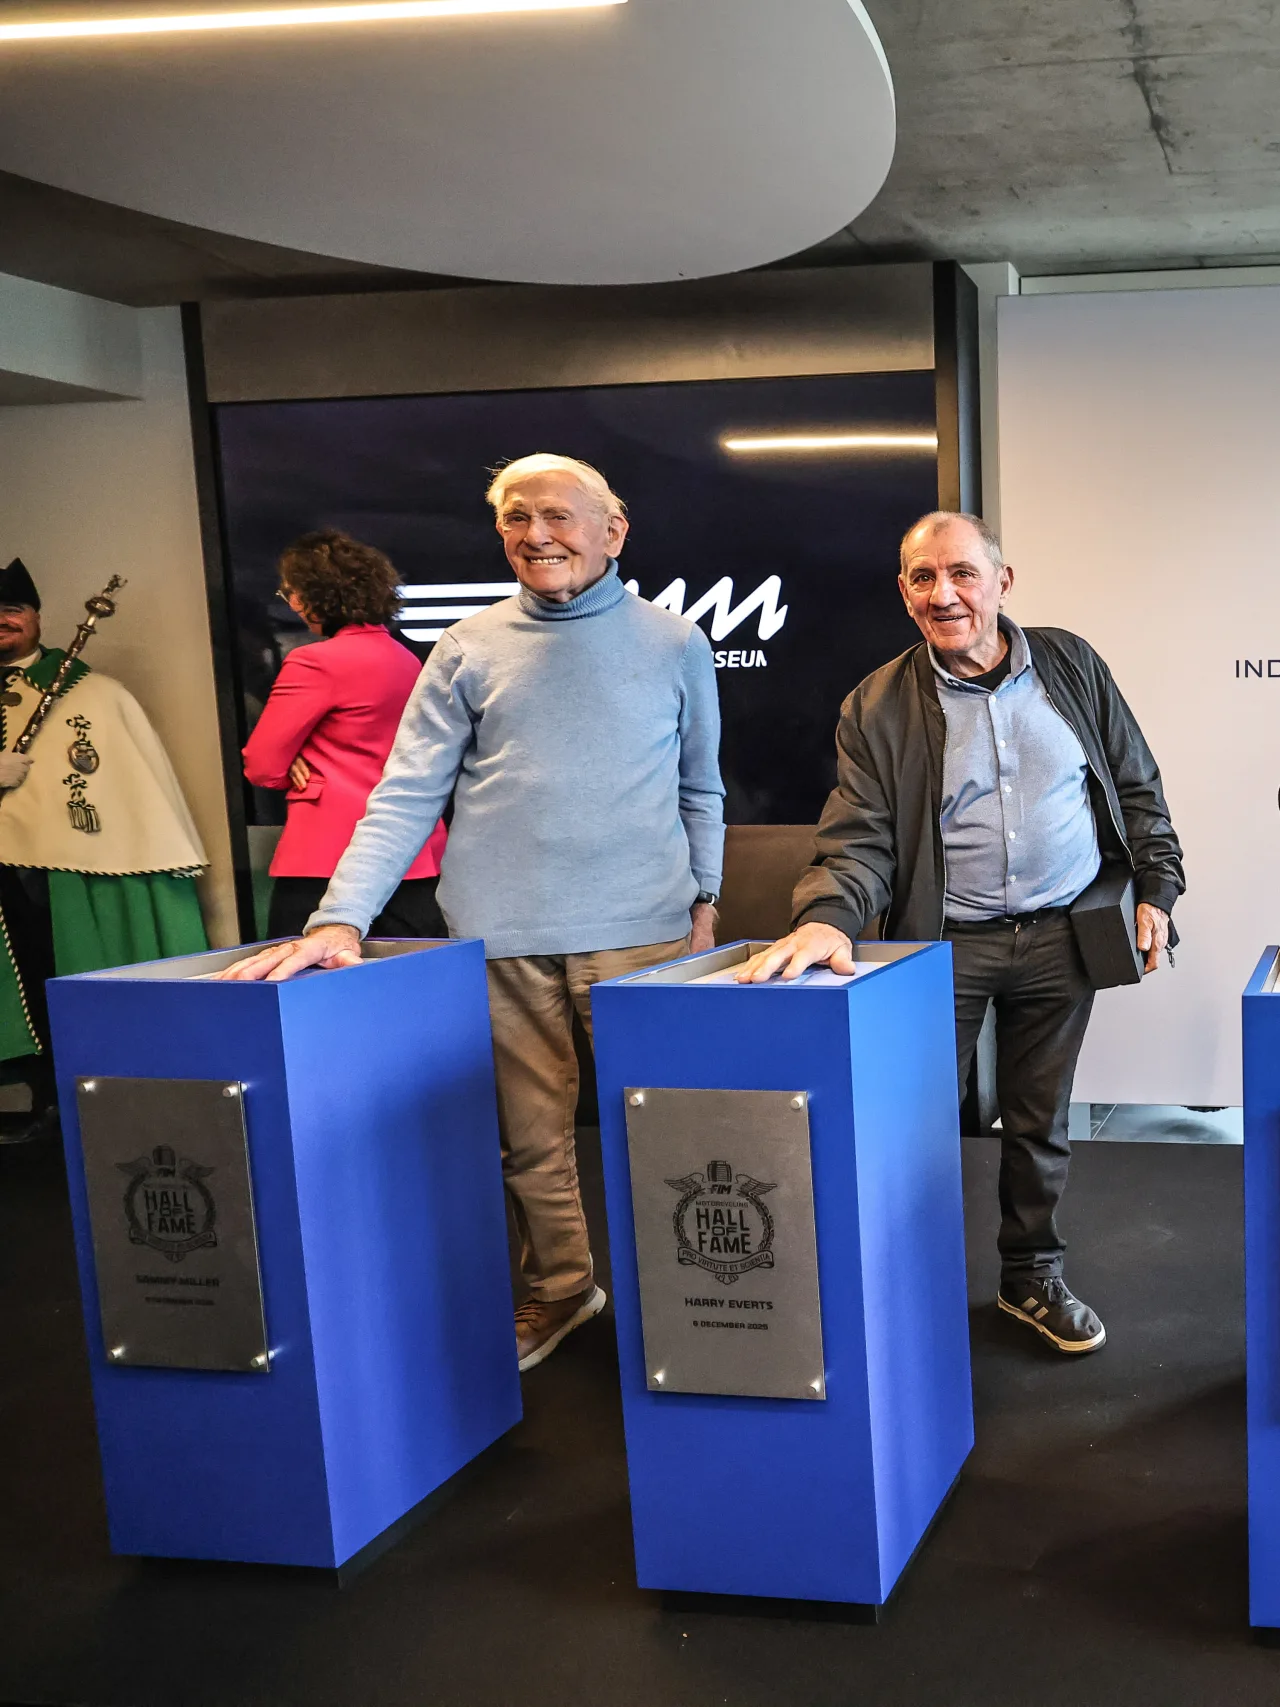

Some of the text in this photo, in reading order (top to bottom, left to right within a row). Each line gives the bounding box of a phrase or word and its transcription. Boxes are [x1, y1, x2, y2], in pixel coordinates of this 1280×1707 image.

[707, 1184, 732, 1194] FIM
[143, 1189, 194, 1213] HALL
[146, 1212, 197, 1235] FAME
[696, 1208, 750, 1231] HALL
[712, 1226, 737, 1236] OF
[698, 1232, 751, 1254] FAME
[682, 1250, 697, 1260] PRO
[685, 1298, 773, 1310] HARRY EVERTS
[701, 1321, 745, 1329] DECEMBER
